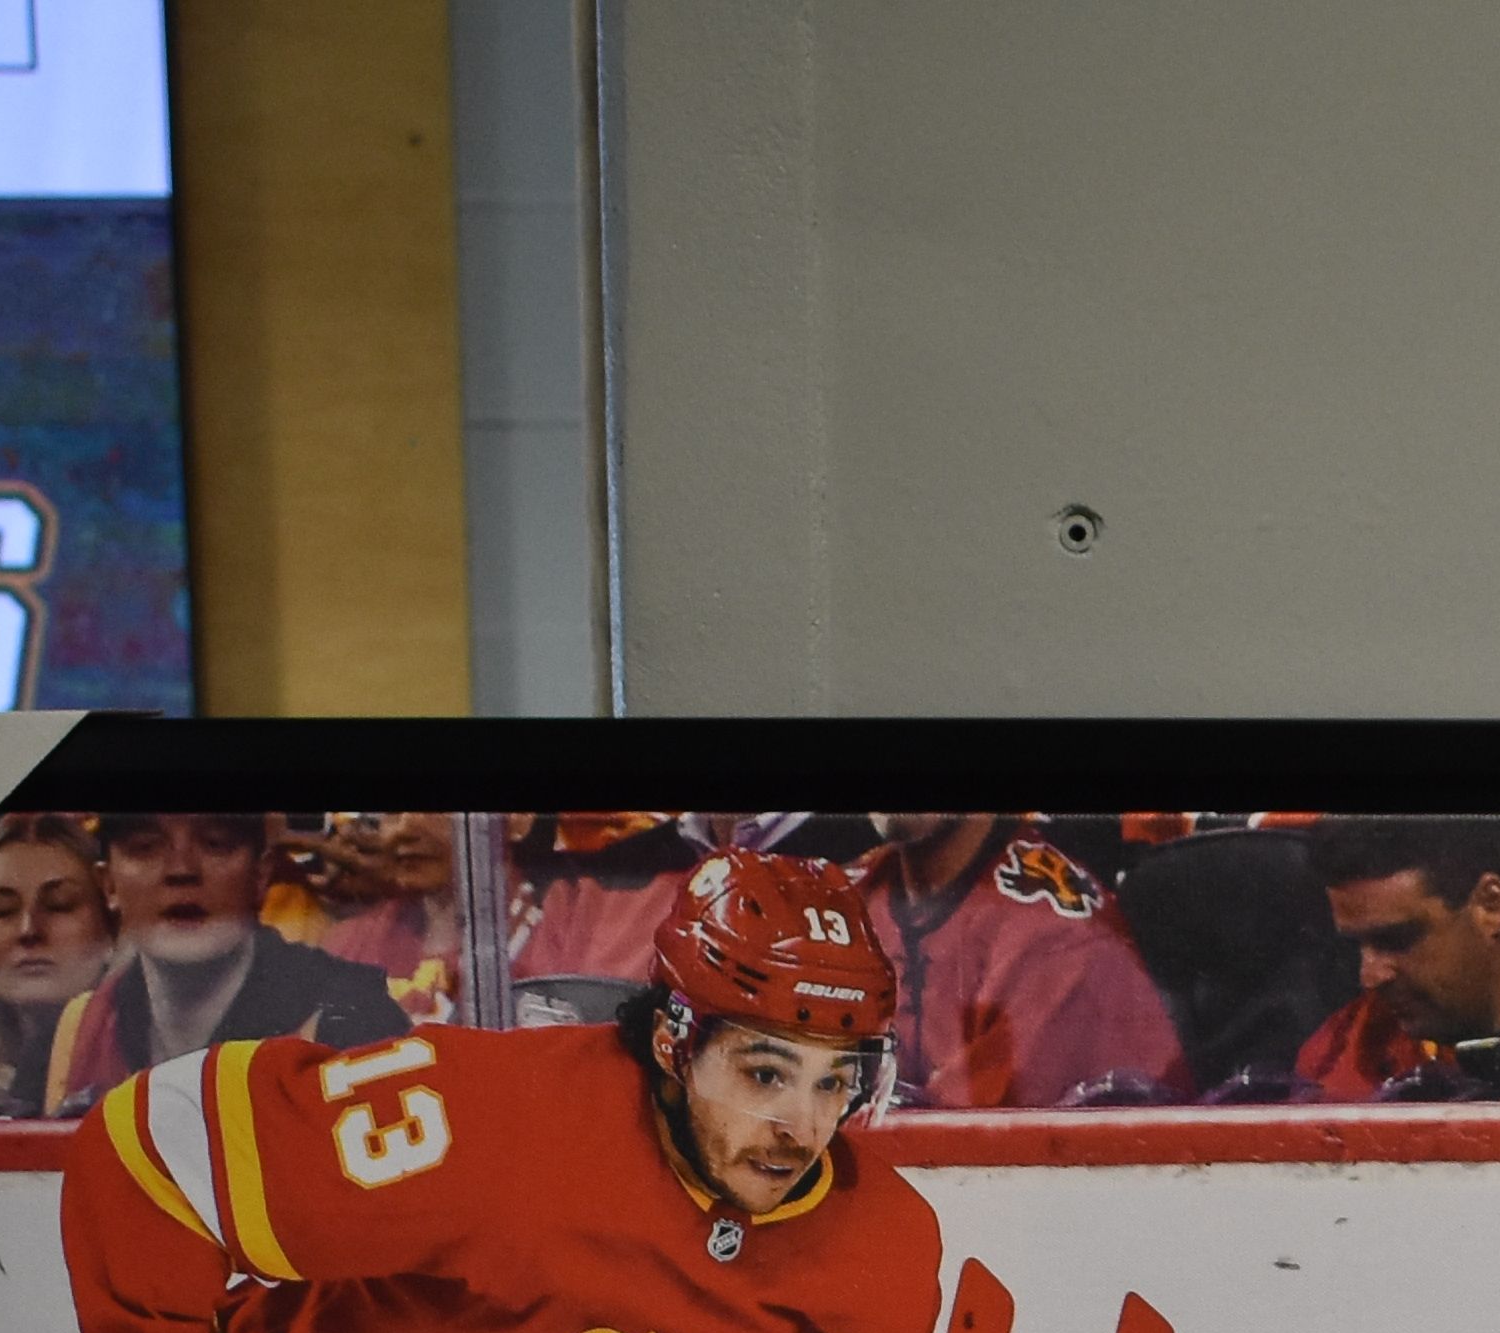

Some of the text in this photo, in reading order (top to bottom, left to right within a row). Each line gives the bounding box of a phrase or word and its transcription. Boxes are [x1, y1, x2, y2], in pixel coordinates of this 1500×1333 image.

[803, 906, 850, 946] 13
[794, 981, 865, 1002] BAUER
[319, 1036, 452, 1190] 13
